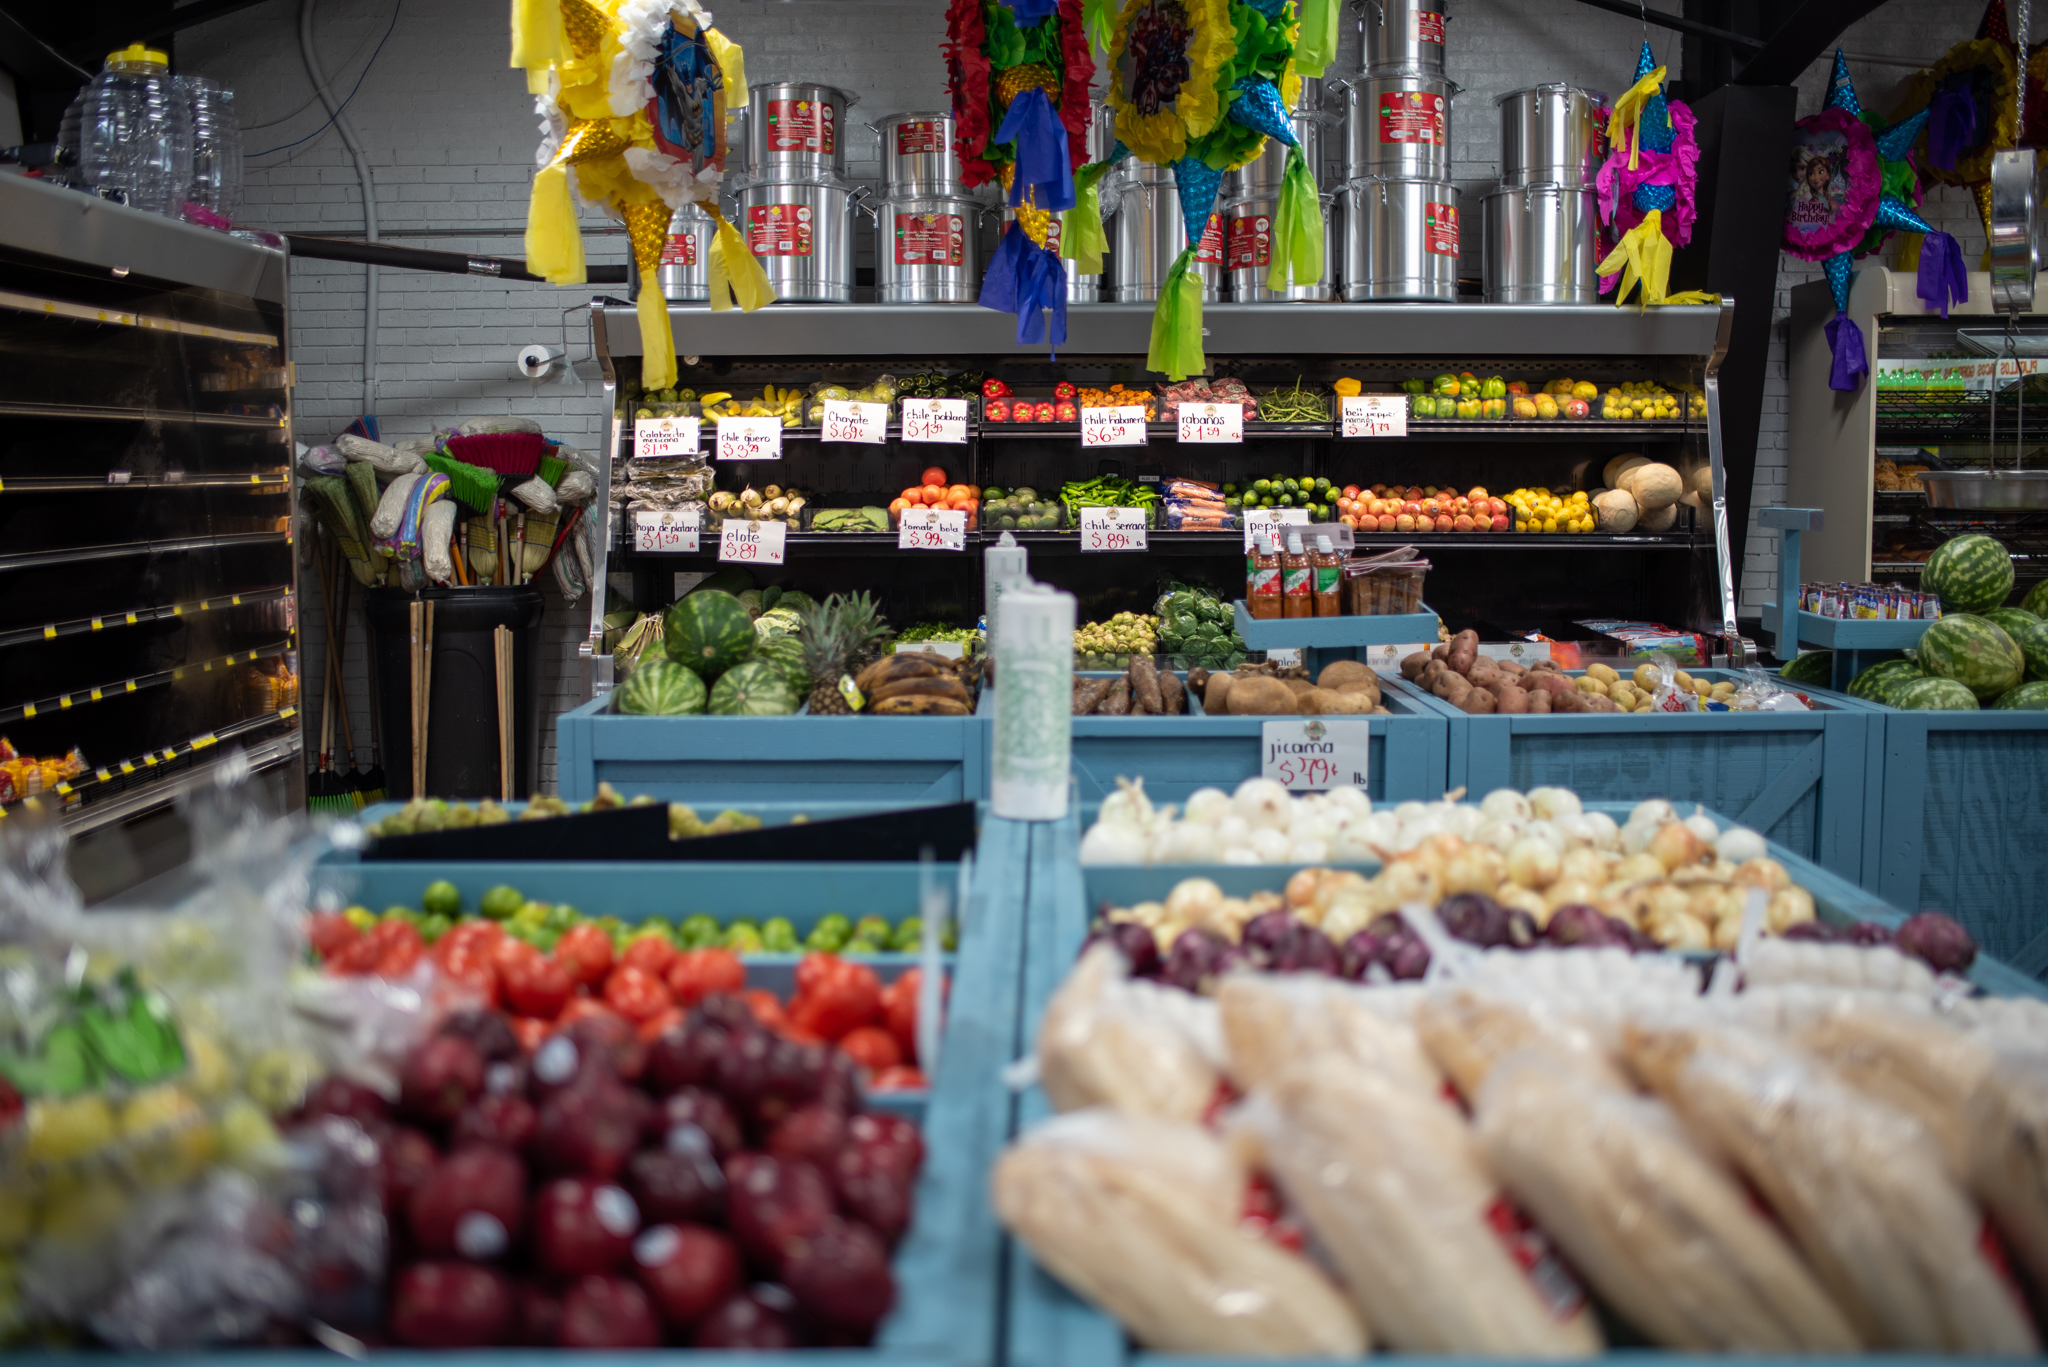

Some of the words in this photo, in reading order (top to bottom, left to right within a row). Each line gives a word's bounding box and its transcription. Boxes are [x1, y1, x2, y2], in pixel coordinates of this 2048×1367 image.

[1798, 202, 1824, 213] Happy
[1791, 211, 1830, 225] Birthday!
[828, 411, 869, 427] Chayote
[906, 408, 930, 419] chile
[1084, 412, 1107, 425] chile
[1182, 413, 1225, 425] rabanos
[721, 432, 740, 442] chile
[1087, 426, 1125, 444] $6.59
[636, 522, 655, 535] hoja
[659, 521, 669, 532] de
[670, 520, 700, 534] platano
[904, 519, 933, 531] tomate
[939, 523, 958, 532] bola
[1084, 519, 1111, 530] chile
[726, 528, 761, 543] elote
[725, 542, 757, 560] $.89
[1268, 739, 1334, 764] jicama
[1353, 772, 1367, 785] lb
